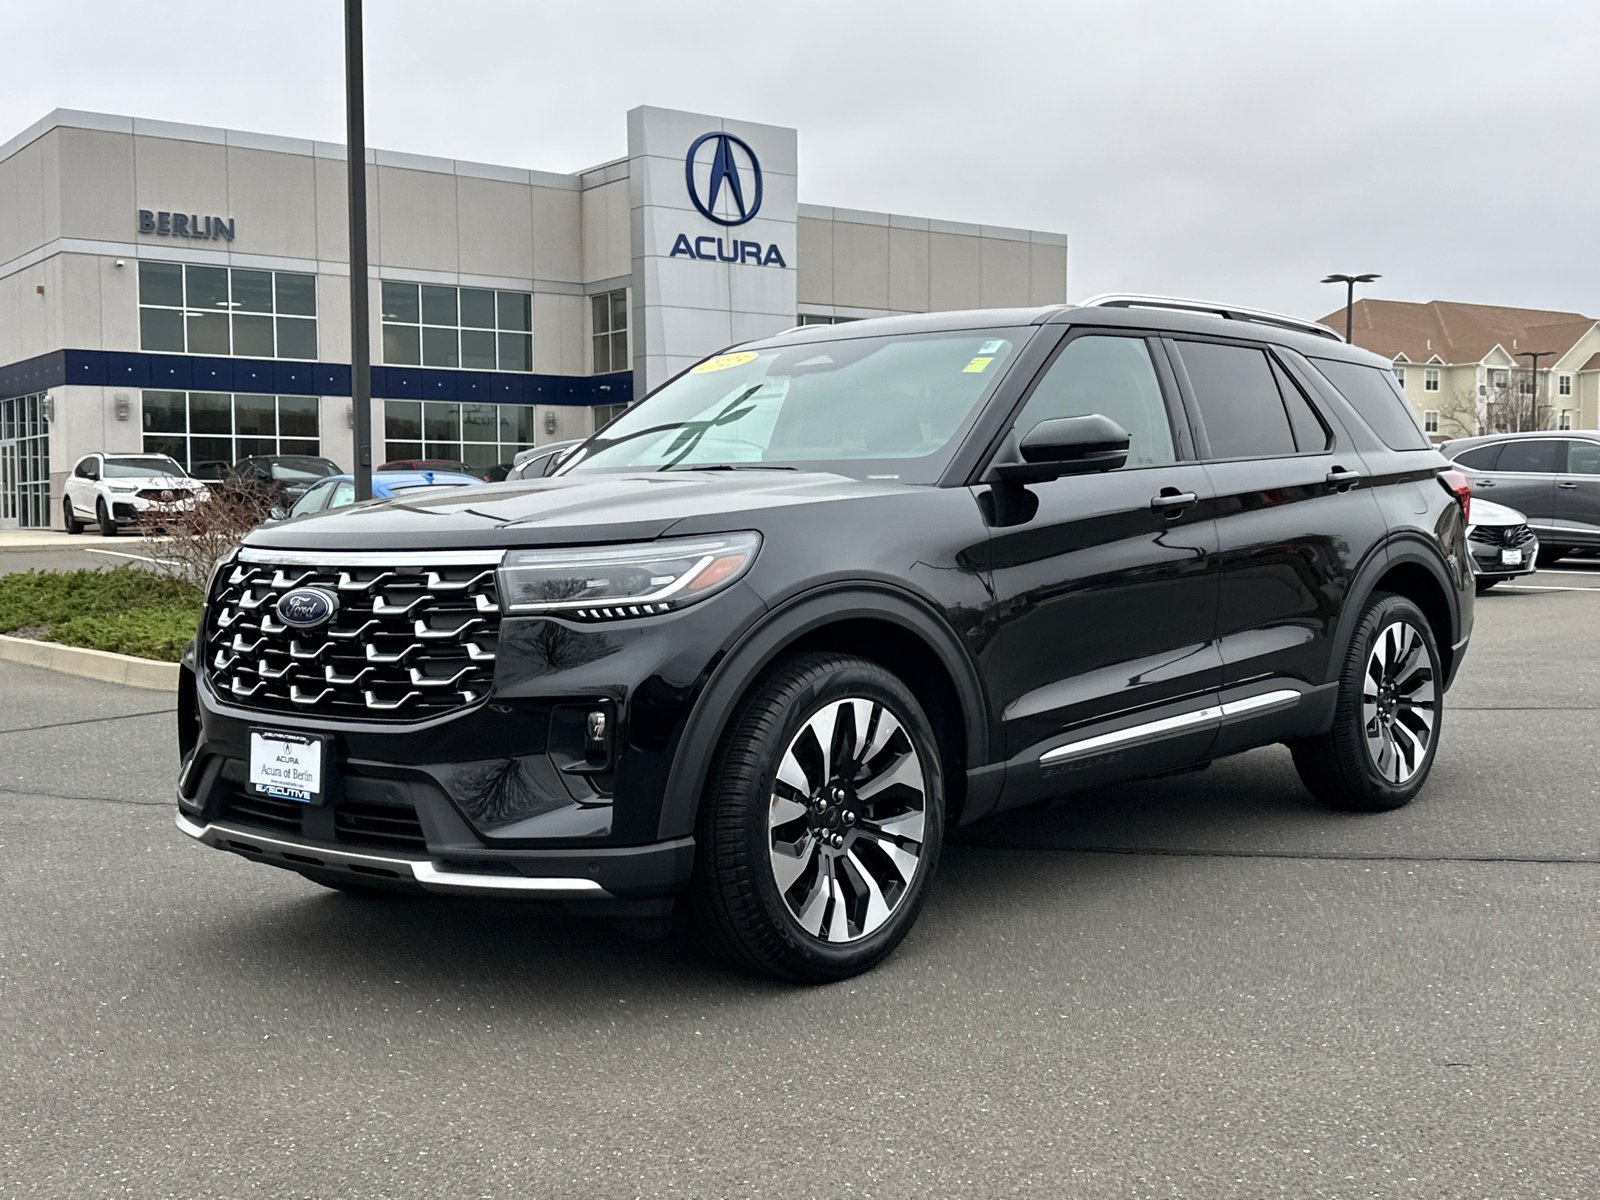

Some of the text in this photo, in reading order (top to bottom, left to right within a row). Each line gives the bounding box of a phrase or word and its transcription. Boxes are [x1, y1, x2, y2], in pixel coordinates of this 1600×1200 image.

[138, 208, 235, 241] BERLIN
[669, 233, 787, 268] ACURA
[286, 596, 318, 618] Ford
[276, 755, 300, 765] ACURA
[261, 764, 313, 782] Acura of Berlin
[255, 783, 311, 800] EXECUTIVE
